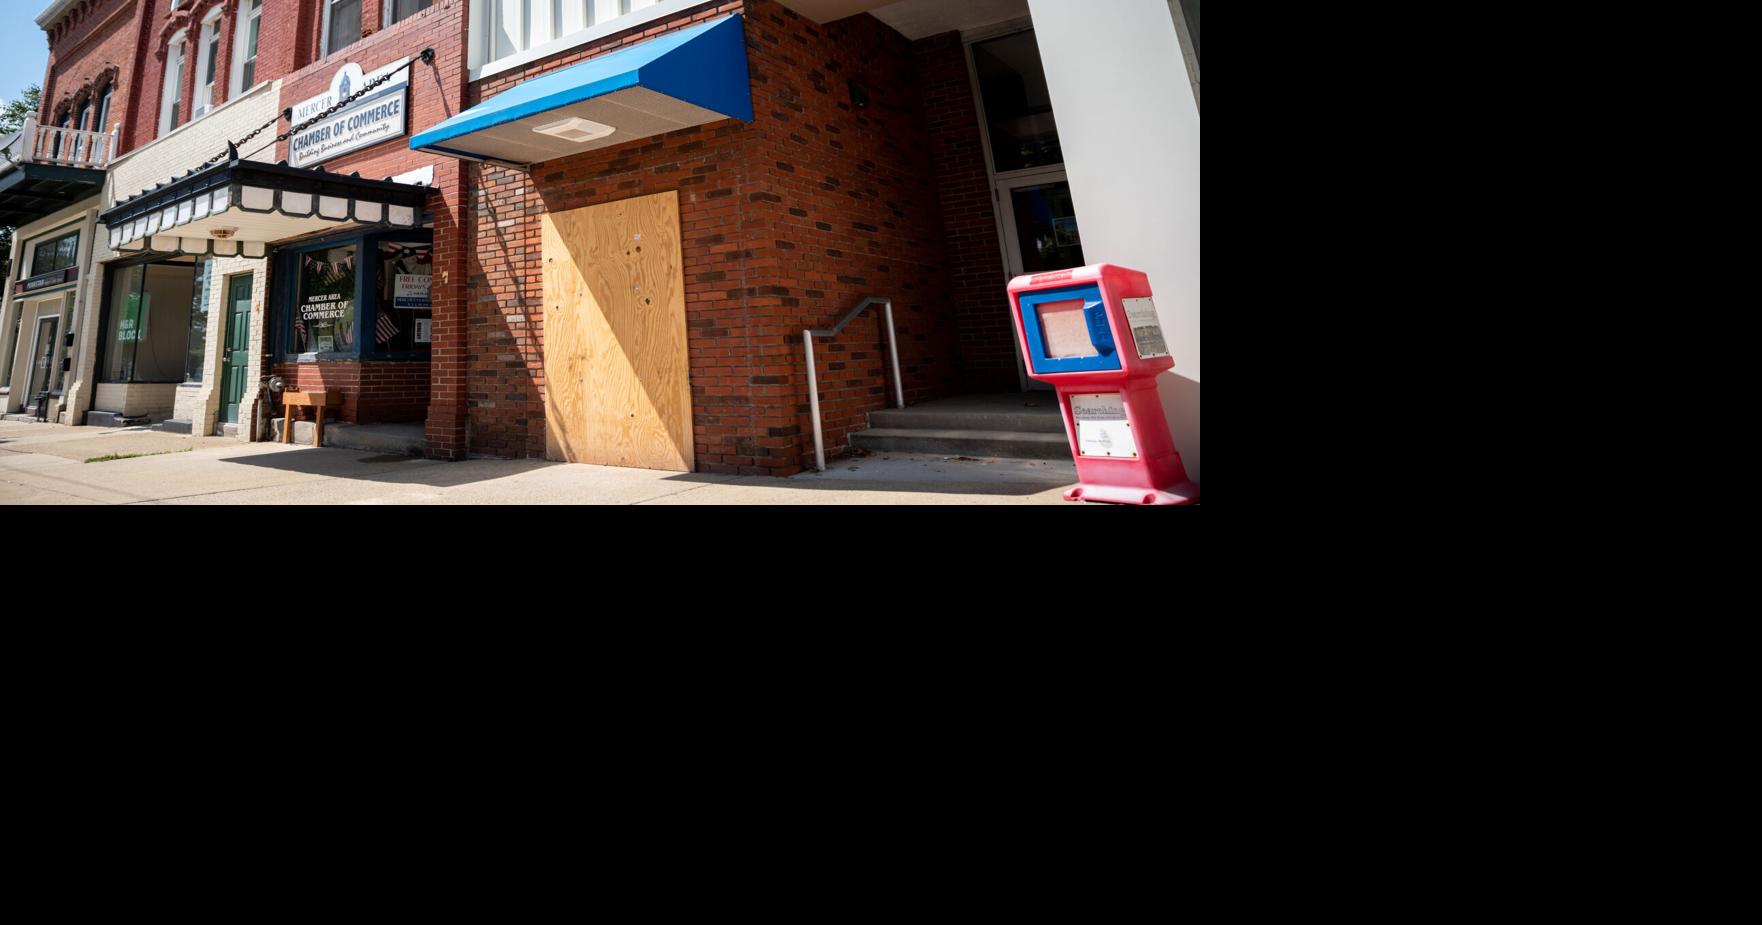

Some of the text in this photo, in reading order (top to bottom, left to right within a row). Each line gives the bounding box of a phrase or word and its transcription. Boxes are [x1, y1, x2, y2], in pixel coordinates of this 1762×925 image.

[298, 96, 332, 118] MERCER
[293, 99, 400, 151] CHAMBER OF COMMERCE
[299, 124, 390, 160] Building Business and Community
[300, 300, 349, 312] CHAMBER OF
[308, 293, 341, 302] MERCER AREA
[303, 310, 344, 320] COMMERCE
